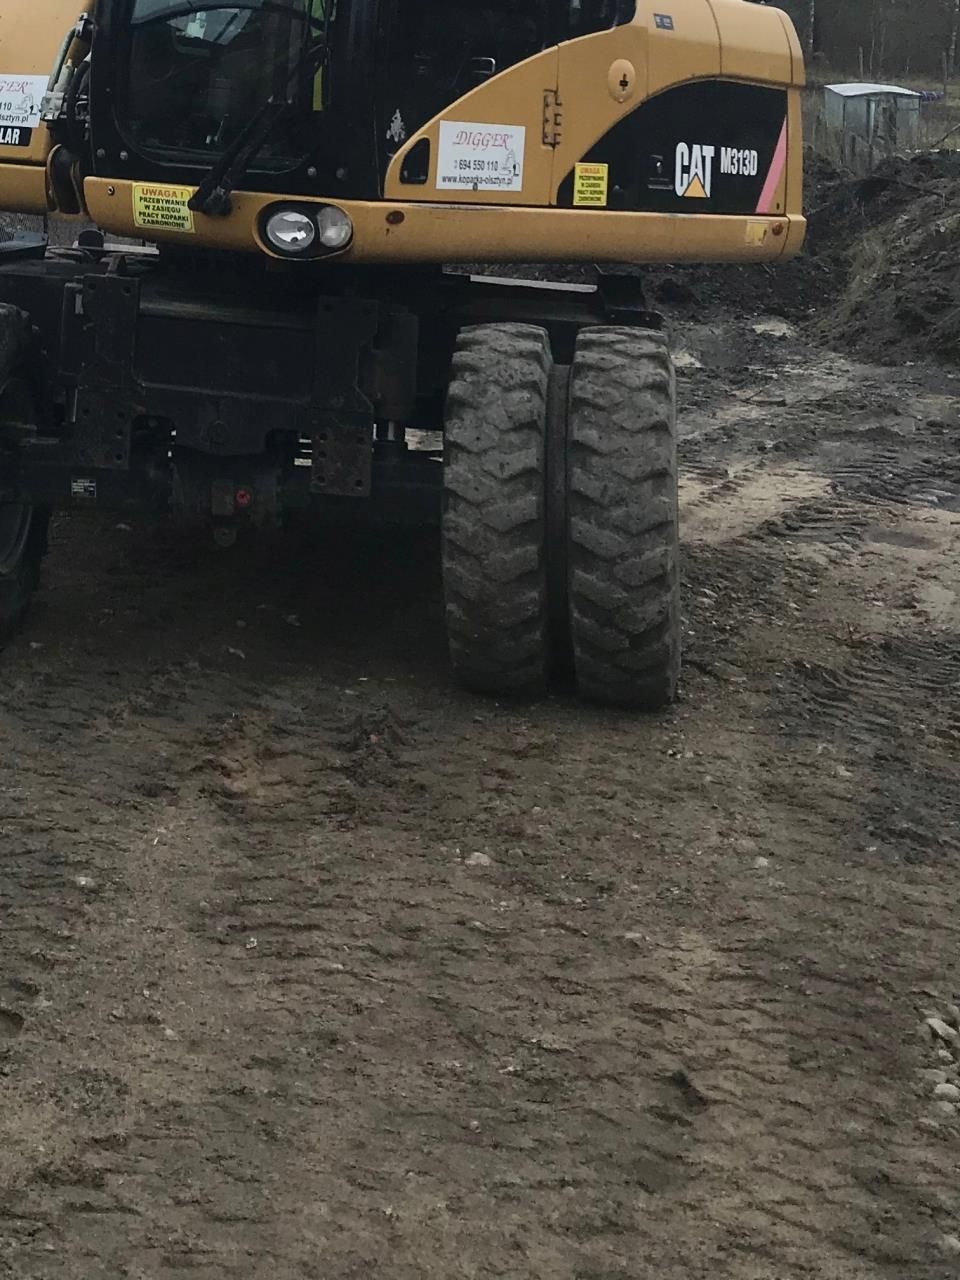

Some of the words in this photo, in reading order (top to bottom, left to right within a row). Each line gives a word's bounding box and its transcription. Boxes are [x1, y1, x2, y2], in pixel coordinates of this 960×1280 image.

[0, 102, 12, 112] 110
[459, 160, 471, 171] 694
[473, 160, 485, 171] 550
[487, 161, 498, 171] 110
[675, 142, 715, 198] CAT
[720, 147, 758, 176] M313D
[142, 187, 177, 199] UWAGA
[139, 196, 186, 207] PRZEBYWANIE
